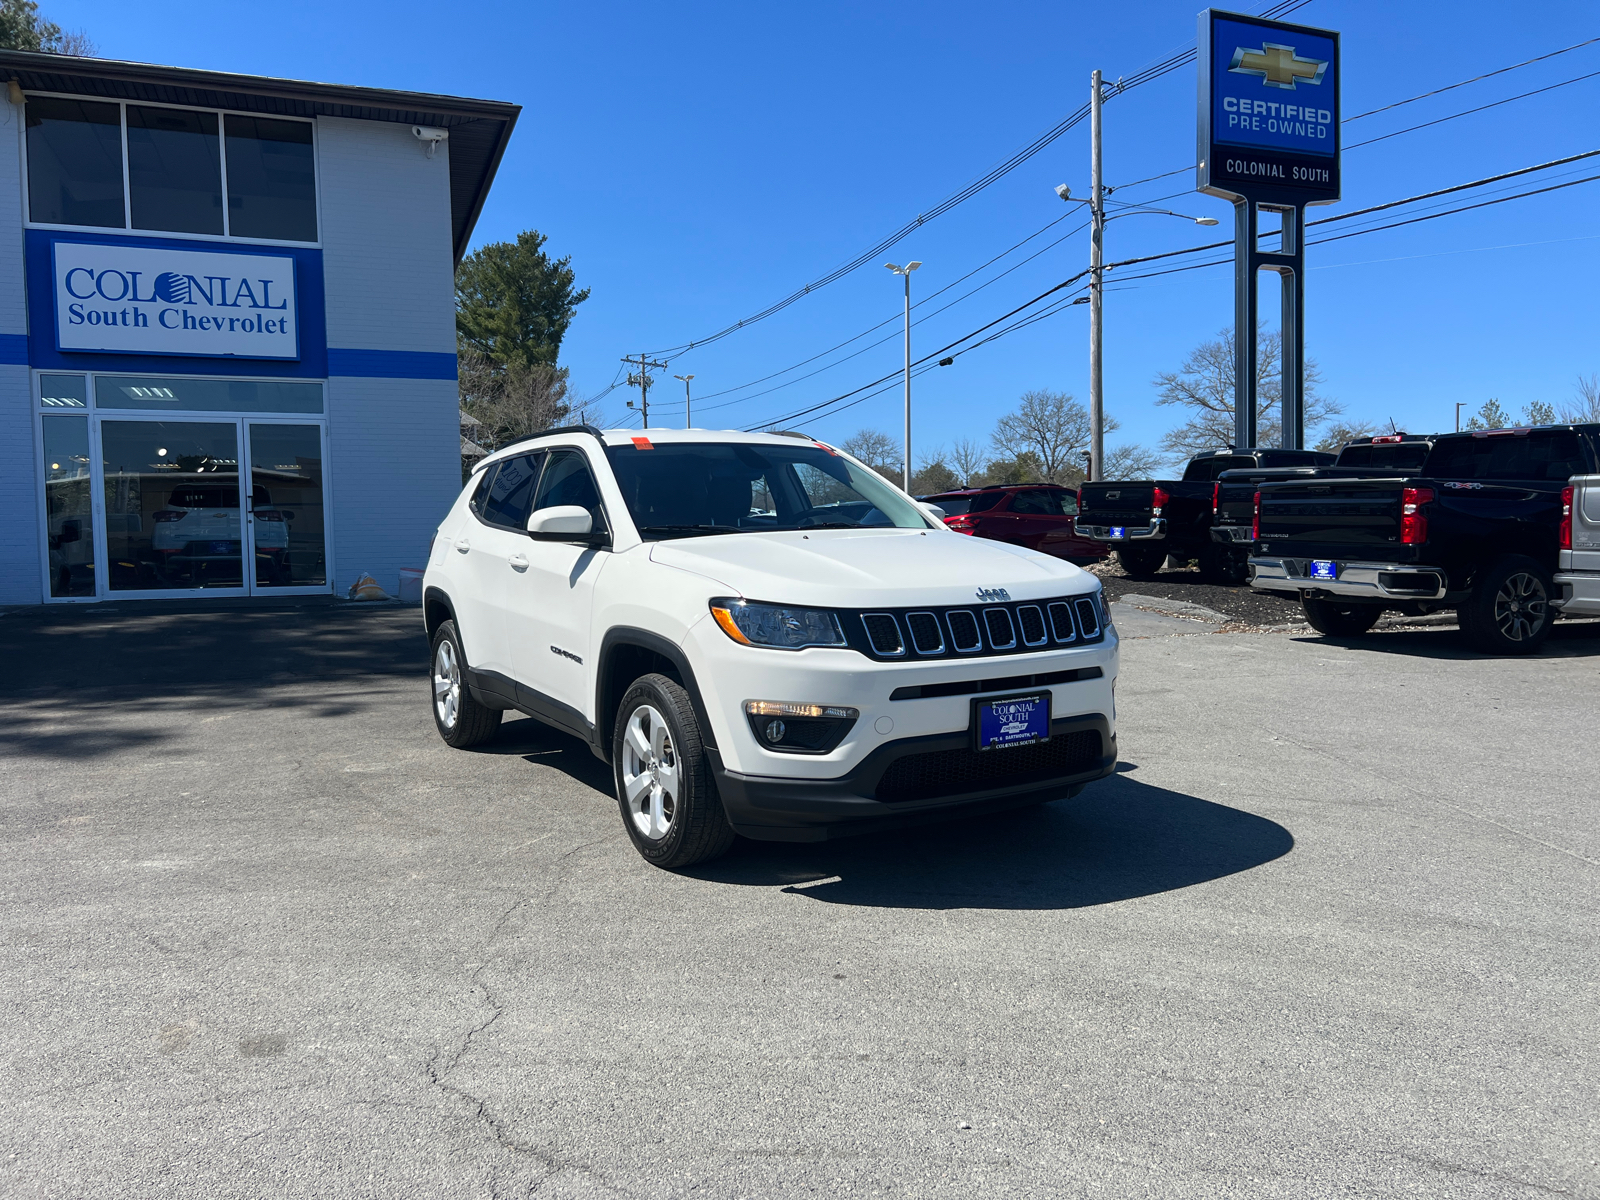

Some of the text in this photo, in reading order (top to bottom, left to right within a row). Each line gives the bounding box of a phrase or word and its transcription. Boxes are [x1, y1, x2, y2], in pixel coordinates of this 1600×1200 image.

[1223, 97, 1331, 124] CERTIFIED
[1229, 114, 1326, 139] PRE-OWNED
[1226, 159, 1329, 182] COLONIAL SOUTH
[65, 267, 288, 310] COLONIAL
[68, 303, 288, 335] South Chevrolet
[975, 587, 1010, 600] Jeep
[993, 703, 1035, 715] COLONIAL
[999, 712, 1028, 723] SOUTH
